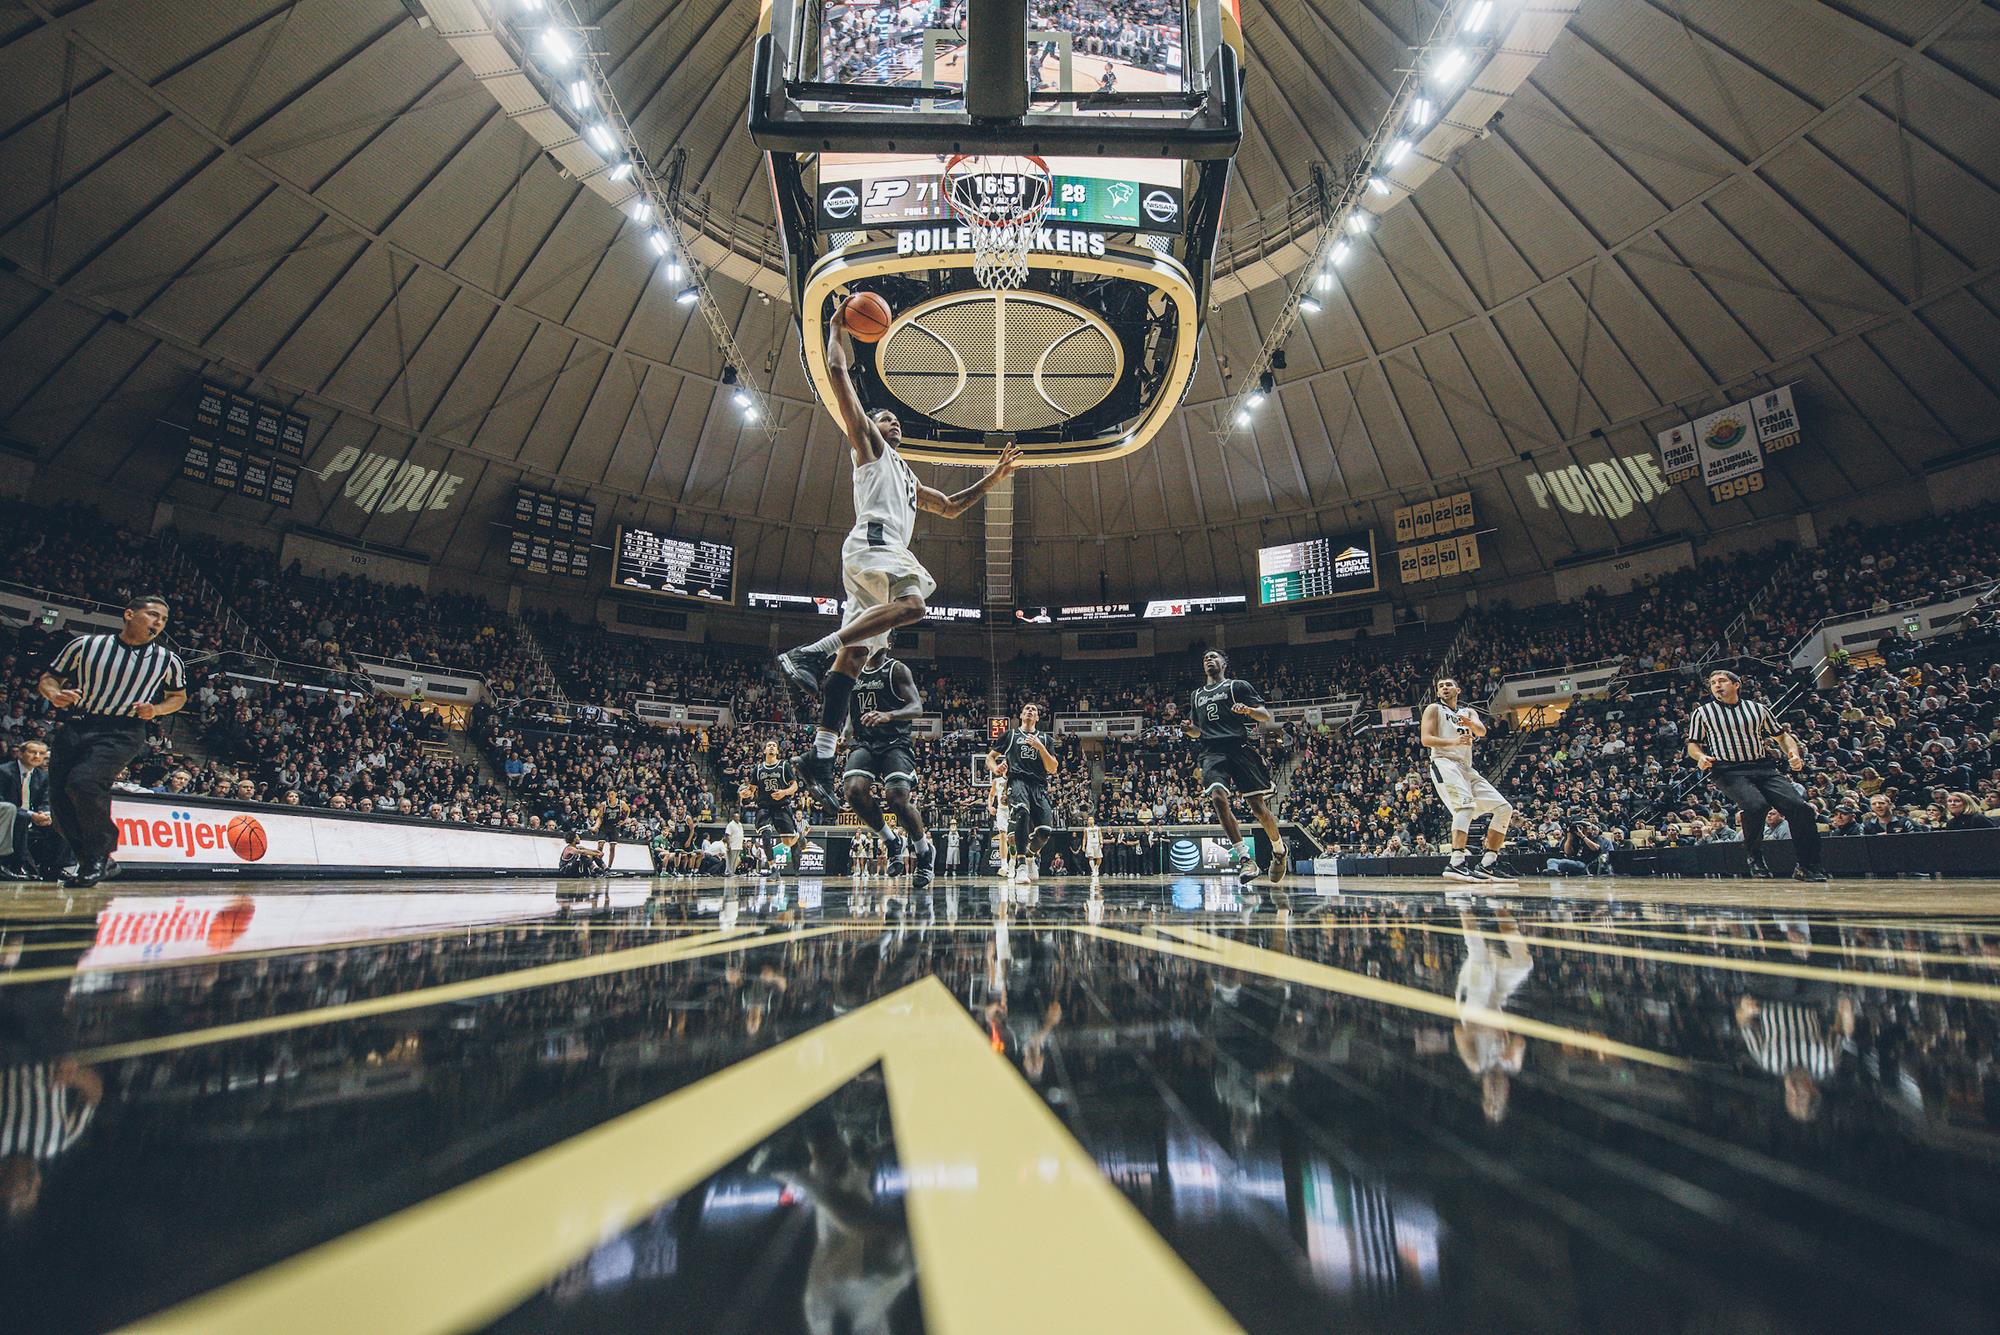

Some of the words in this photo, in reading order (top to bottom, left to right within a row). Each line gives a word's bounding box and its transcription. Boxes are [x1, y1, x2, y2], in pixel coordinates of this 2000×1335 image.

[975, 176, 1026, 195] 16:51
[916, 182, 939, 202] 71
[1061, 184, 1087, 203] 28
[827, 198, 856, 207] NISSAN
[1146, 201, 1175, 211] NISSAN
[904, 206, 928, 216] FOULS
[1759, 409, 1794, 427] FINAL
[1763, 418, 1794, 436] FOUR
[1764, 432, 1800, 454] 2001
[1664, 443, 1694, 460] FINAL
[1668, 452, 1694, 468] FOUR
[1709, 450, 1754, 470] NATIONAL
[1708, 456, 1758, 478] CHAMPIONS
[318, 445, 464, 514] PURDUE
[1668, 466, 1700, 484] 1994
[1525, 452, 1672, 520] PURDUE
[1711, 472, 1764, 502] 1999
[1435, 508, 1452, 520] 22
[1454, 504, 1472, 516] 32
[1398, 518, 1411, 529] 41
[1416, 514, 1432, 526] 40
[1440, 550, 1456, 562] 50
[1465, 546, 1472, 557] 1
[350, 555, 367, 565] 103
[1335, 558, 1370, 568] PURDUE
[1402, 558, 1418, 570] 22
[1421, 554, 1437, 566] 32
[1614, 561, 1631, 571] 108
[1336, 564, 1370, 574] FEDERAL
[925, 606, 946, 616] PLAN
[947, 608, 981, 618] OPTIONS
[1062, 606, 1095, 614] NOVEMBER
[1170, 604, 1182, 614] M
[858, 691, 877, 714] 14
[1206, 704, 1220, 722] 2
[1020, 745, 1038, 760] 23
[764, 778, 778, 792] 35
[116, 811, 227, 857] meijer
[776, 854, 787, 863] 28
[1208, 854, 1218, 862] 71
